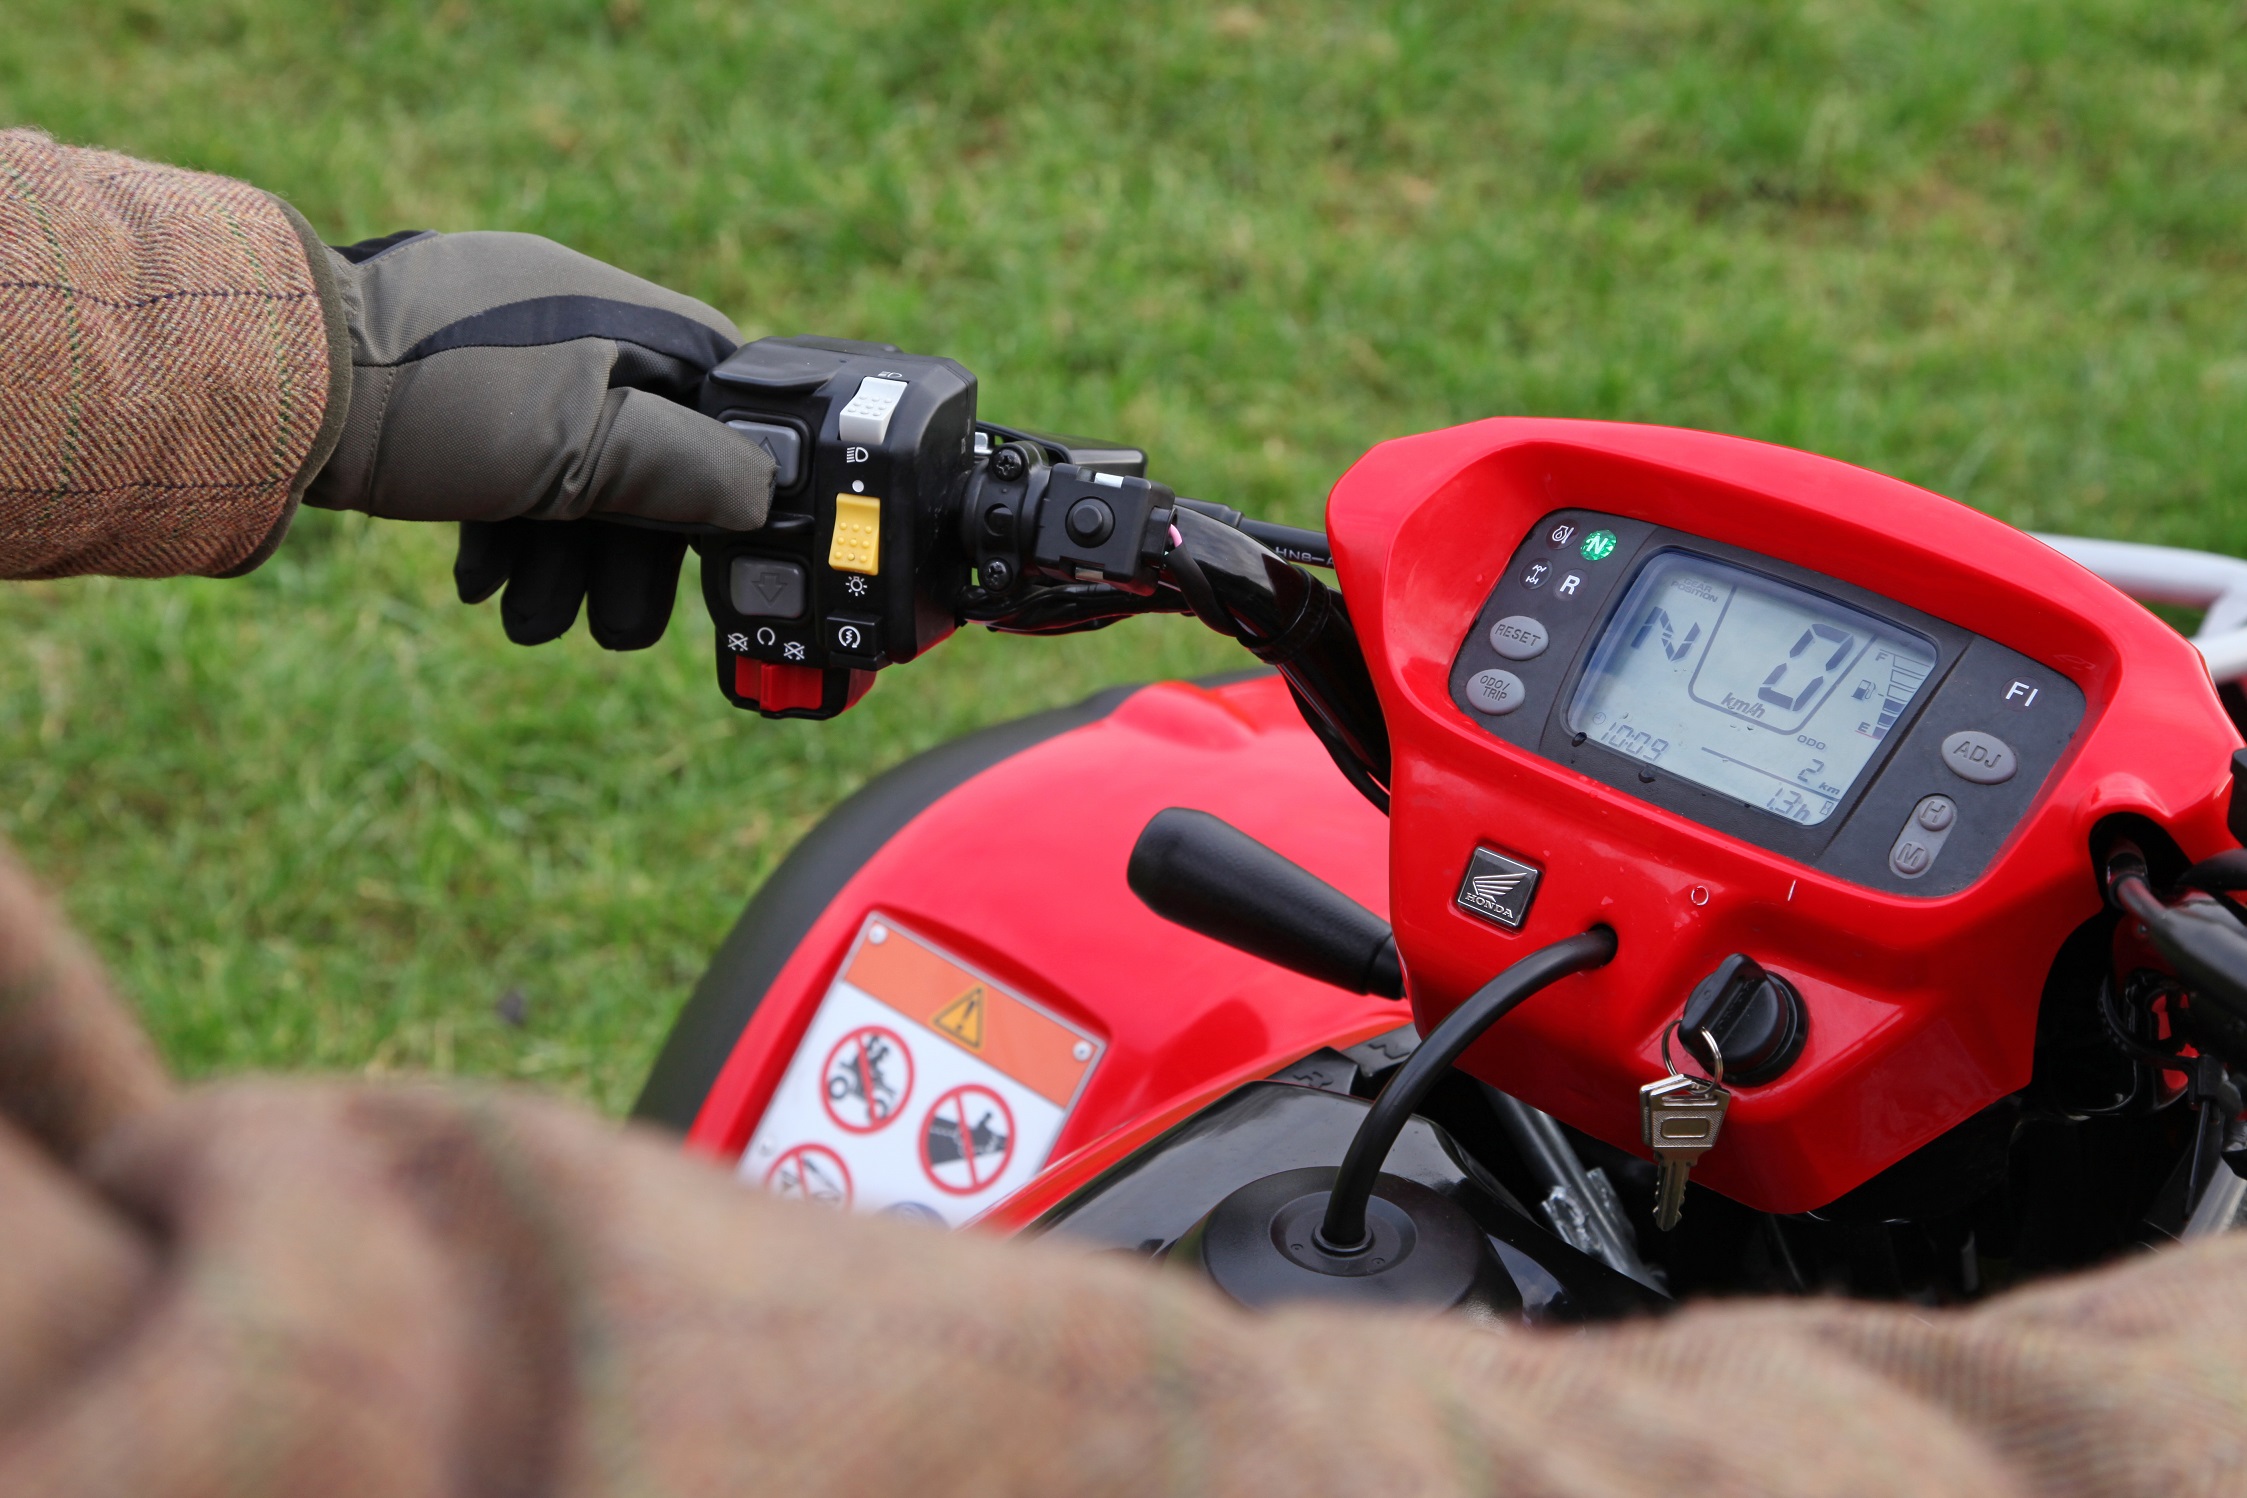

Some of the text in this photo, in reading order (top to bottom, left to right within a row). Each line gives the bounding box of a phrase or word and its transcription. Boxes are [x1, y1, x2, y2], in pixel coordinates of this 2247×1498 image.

[1585, 535, 1609, 555] N
[1559, 574, 1581, 595] R
[1670, 580, 1719, 603] POSITION
[1683, 577, 1713, 593] GEAR
[1494, 623, 1542, 647] RESET
[1757, 623, 1855, 712] 0
[1875, 651, 1889, 662] F
[1480, 675, 1511, 691] ODO/
[1482, 685, 1508, 702] TRIP
[2005, 681, 2039, 707] FI
[1720, 691, 1766, 719] km/h
[1857, 721, 1871, 733] E
[1797, 734, 1827, 751] ODO
[1952, 740, 2002, 769] ADJ
[1797, 758, 1841, 796] 2 km
[1920, 800, 1947, 824] H
[1896, 842, 1925, 867] M
[1464, 891, 1514, 919] HONDA
